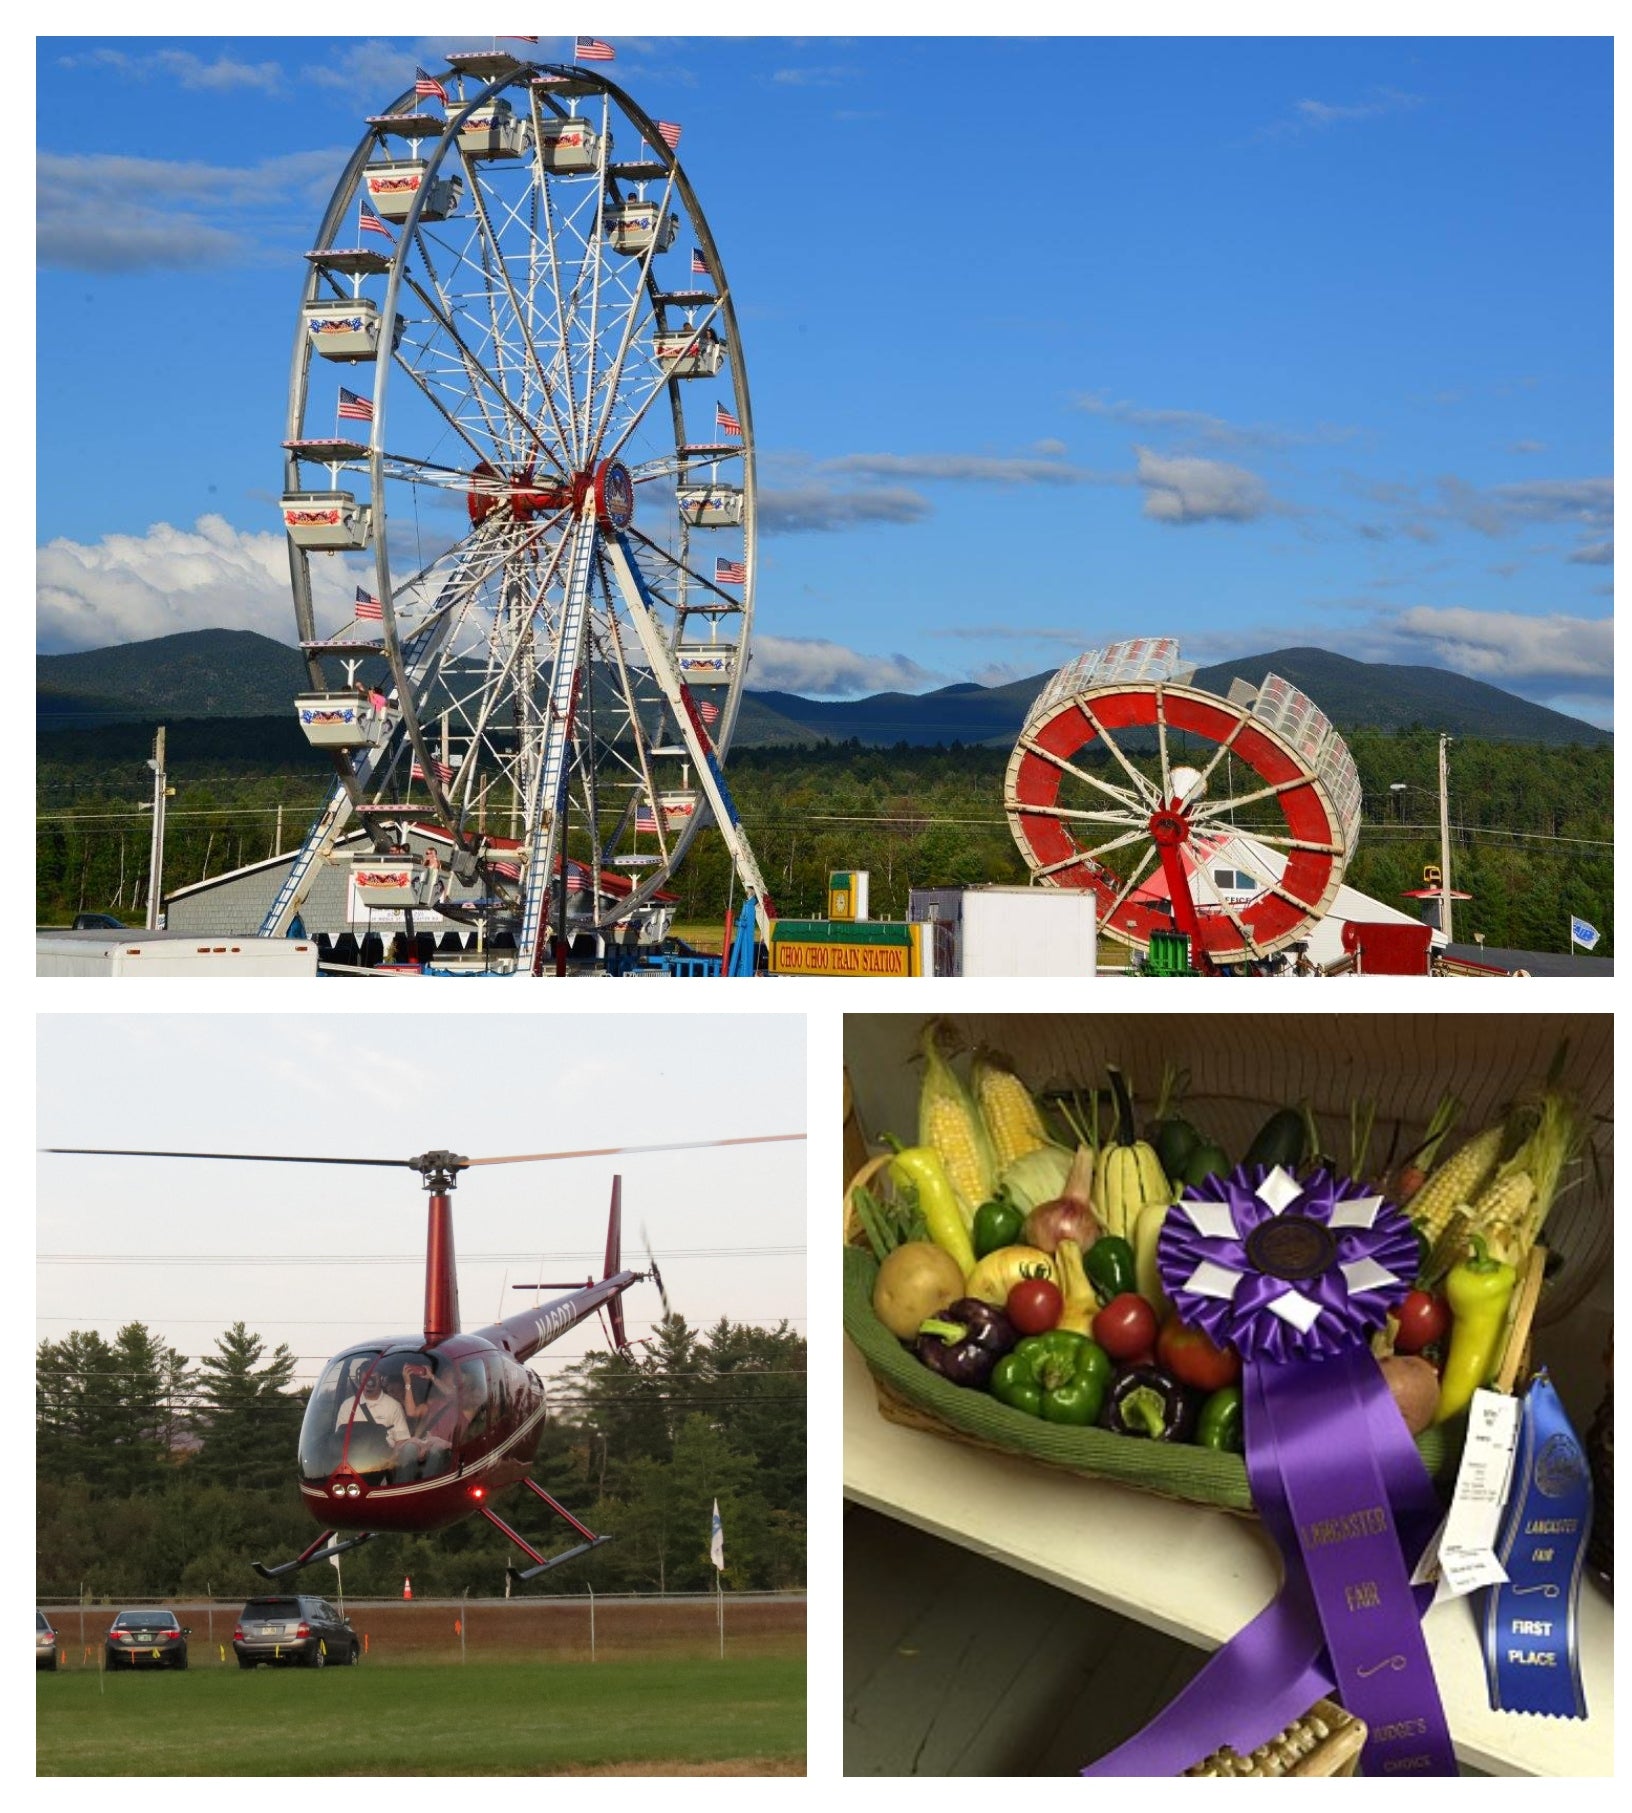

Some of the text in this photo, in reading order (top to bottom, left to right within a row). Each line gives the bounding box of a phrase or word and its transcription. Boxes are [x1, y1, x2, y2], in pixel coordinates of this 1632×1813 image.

[780, 946, 903, 973] CHOO CHOO TRAIN STATION
[1512, 1620, 1552, 1637] FIRST
[1508, 1649, 1557, 1666] PLACE
